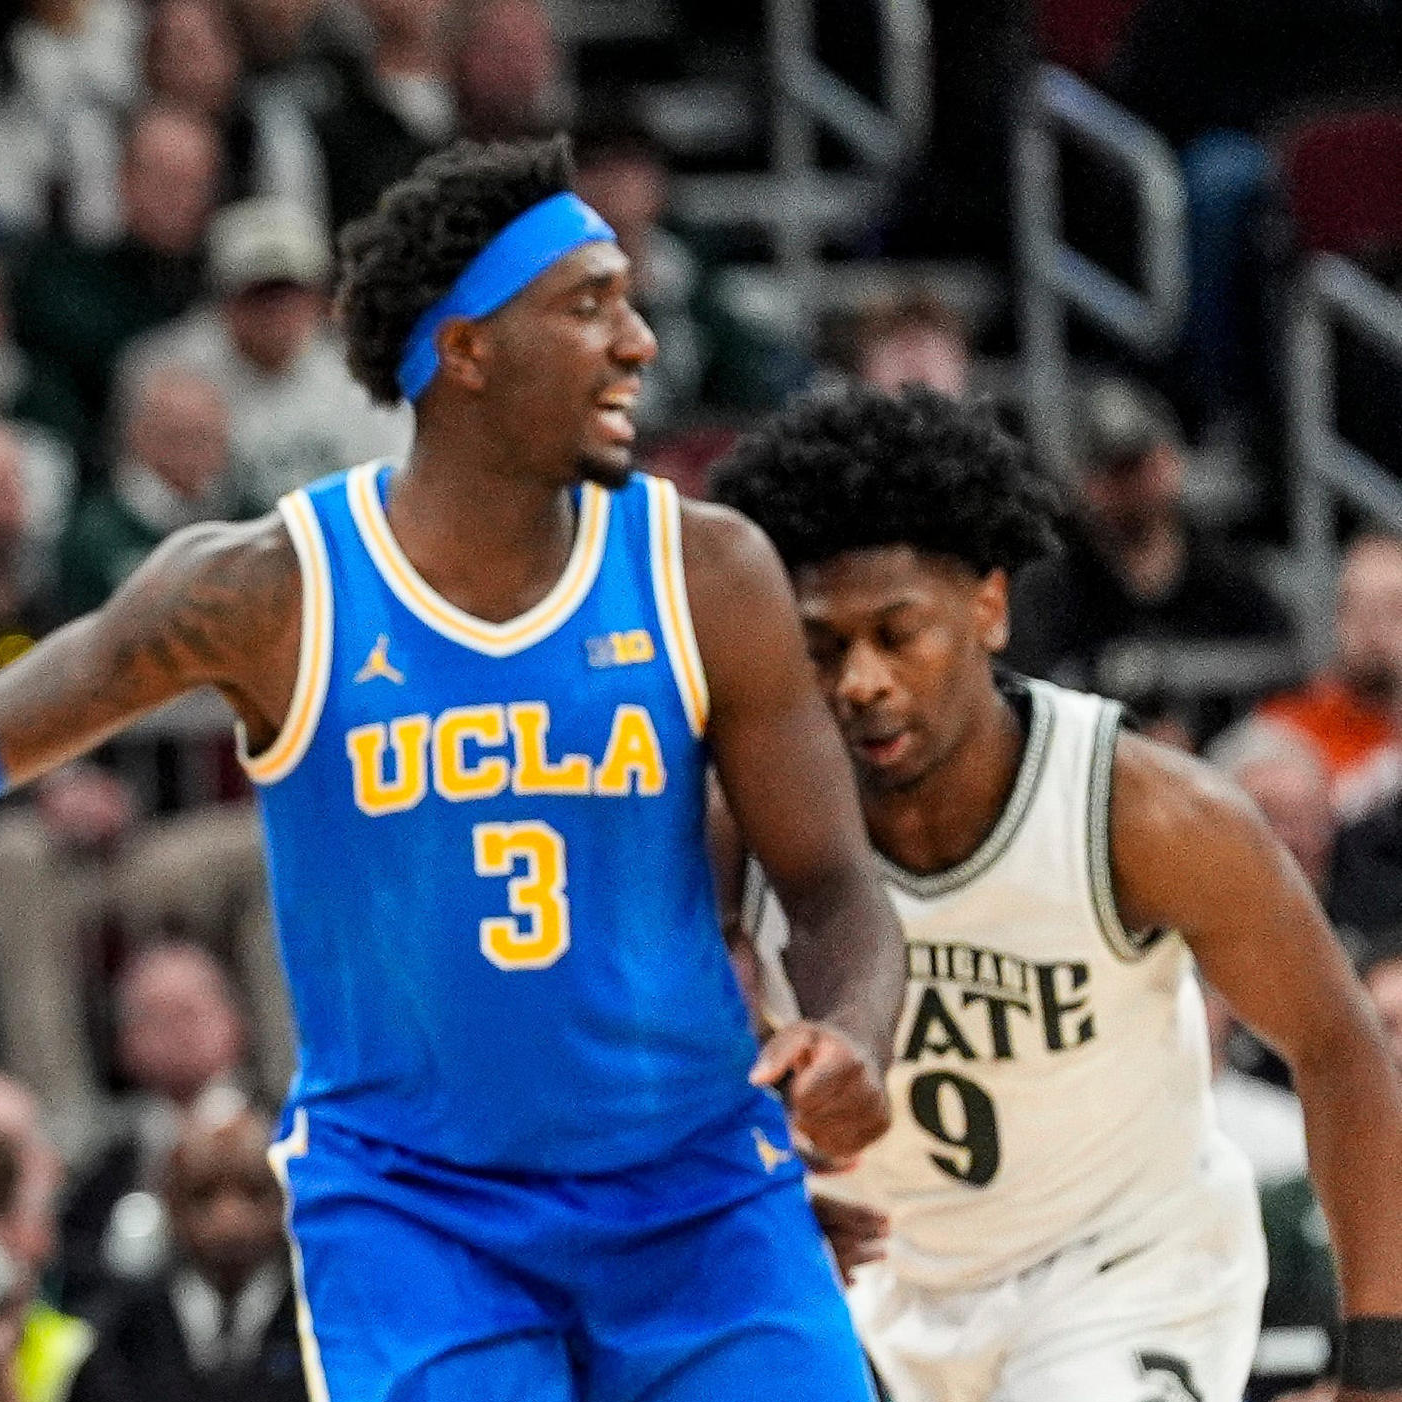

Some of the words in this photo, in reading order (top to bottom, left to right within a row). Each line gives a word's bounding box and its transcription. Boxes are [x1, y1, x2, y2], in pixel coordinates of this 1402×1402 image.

[346, 700, 667, 817] UCLA
[472, 819, 571, 971] 3
[901, 959, 1096, 1060] ATE
[908, 1068, 1001, 1189] 9
